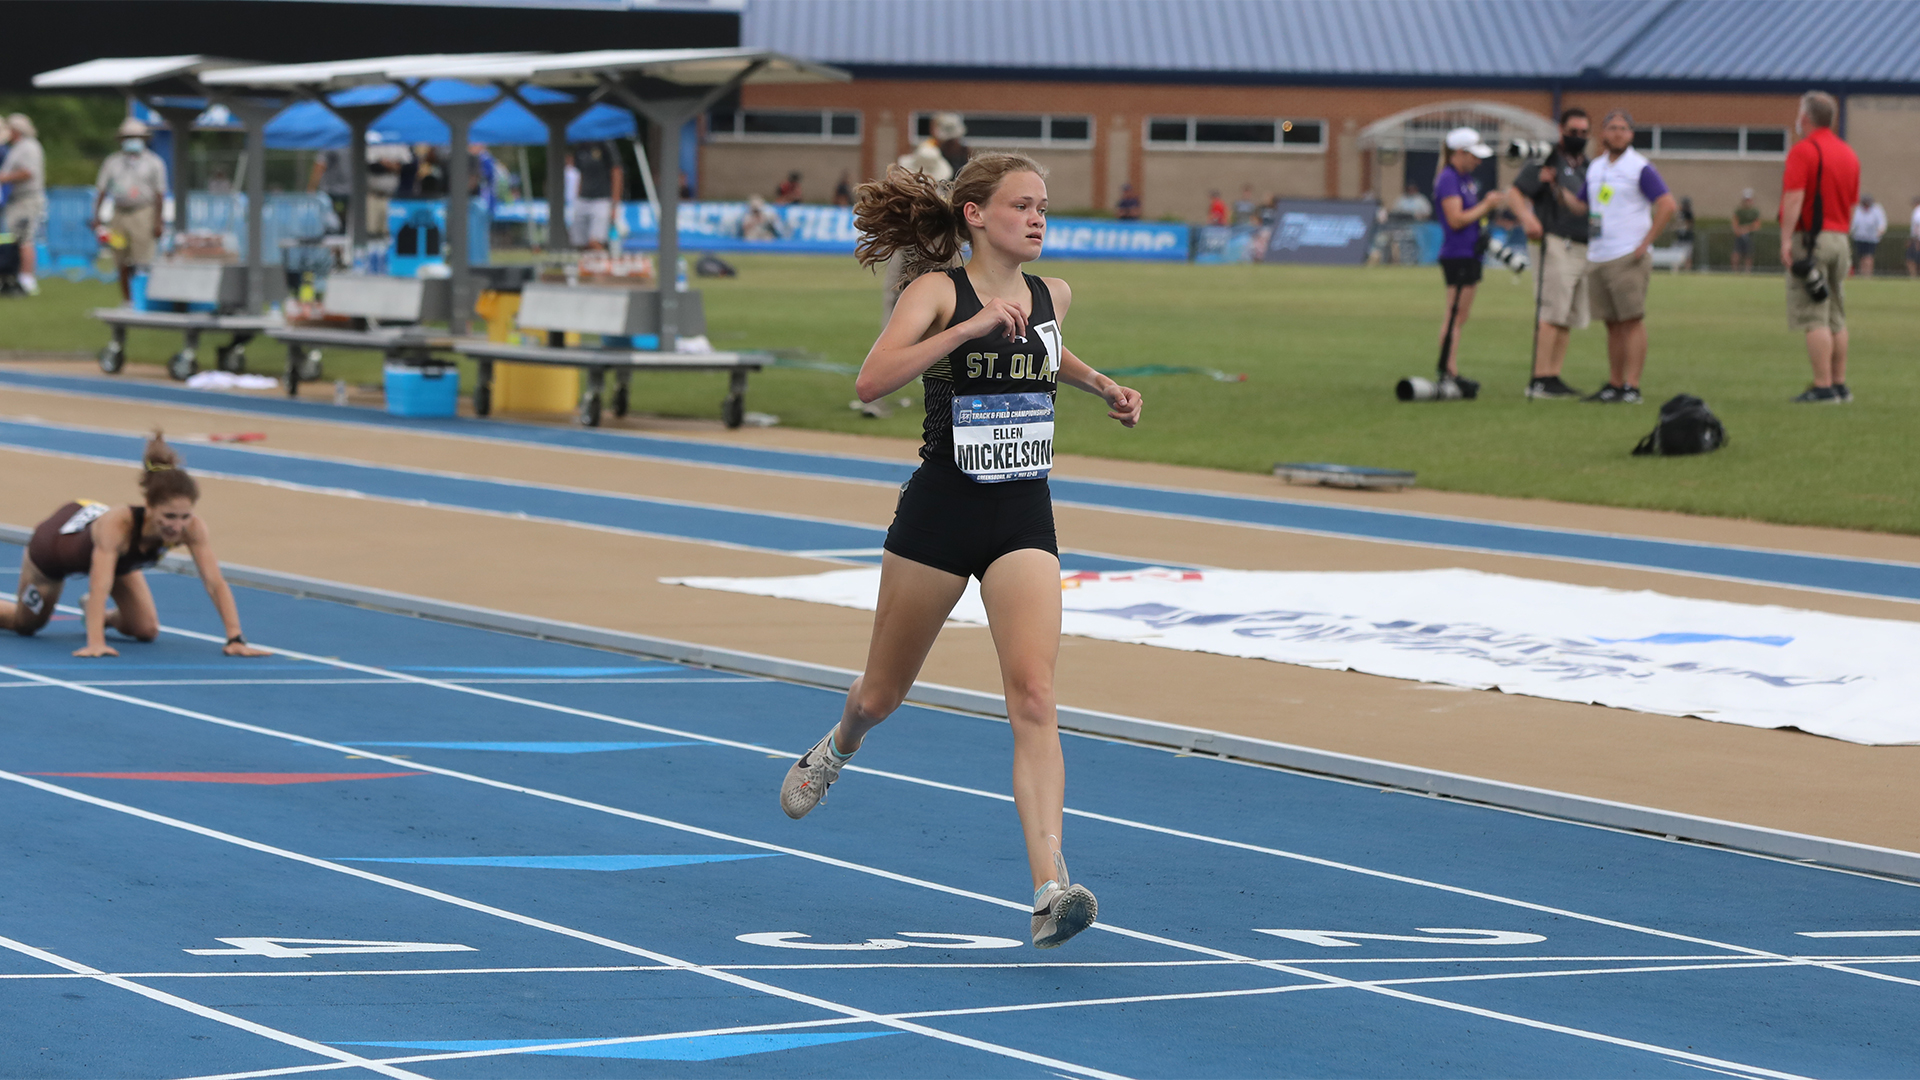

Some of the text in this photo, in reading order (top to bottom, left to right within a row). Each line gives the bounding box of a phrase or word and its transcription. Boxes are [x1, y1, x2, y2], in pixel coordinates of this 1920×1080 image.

[1041, 324, 1060, 368] 7
[966, 352, 1056, 383] ST. OLA
[972, 412, 990, 420] TRACK
[995, 411, 1010, 419] FIELD
[1010, 409, 1051, 418] CHAMPIONSHIPS
[993, 427, 1023, 440] ELLEN
[957, 439, 1052, 471] MICKELSON
[182, 937, 480, 958] 4
[735, 931, 1024, 950] 3
[1252, 927, 1547, 948] 2
